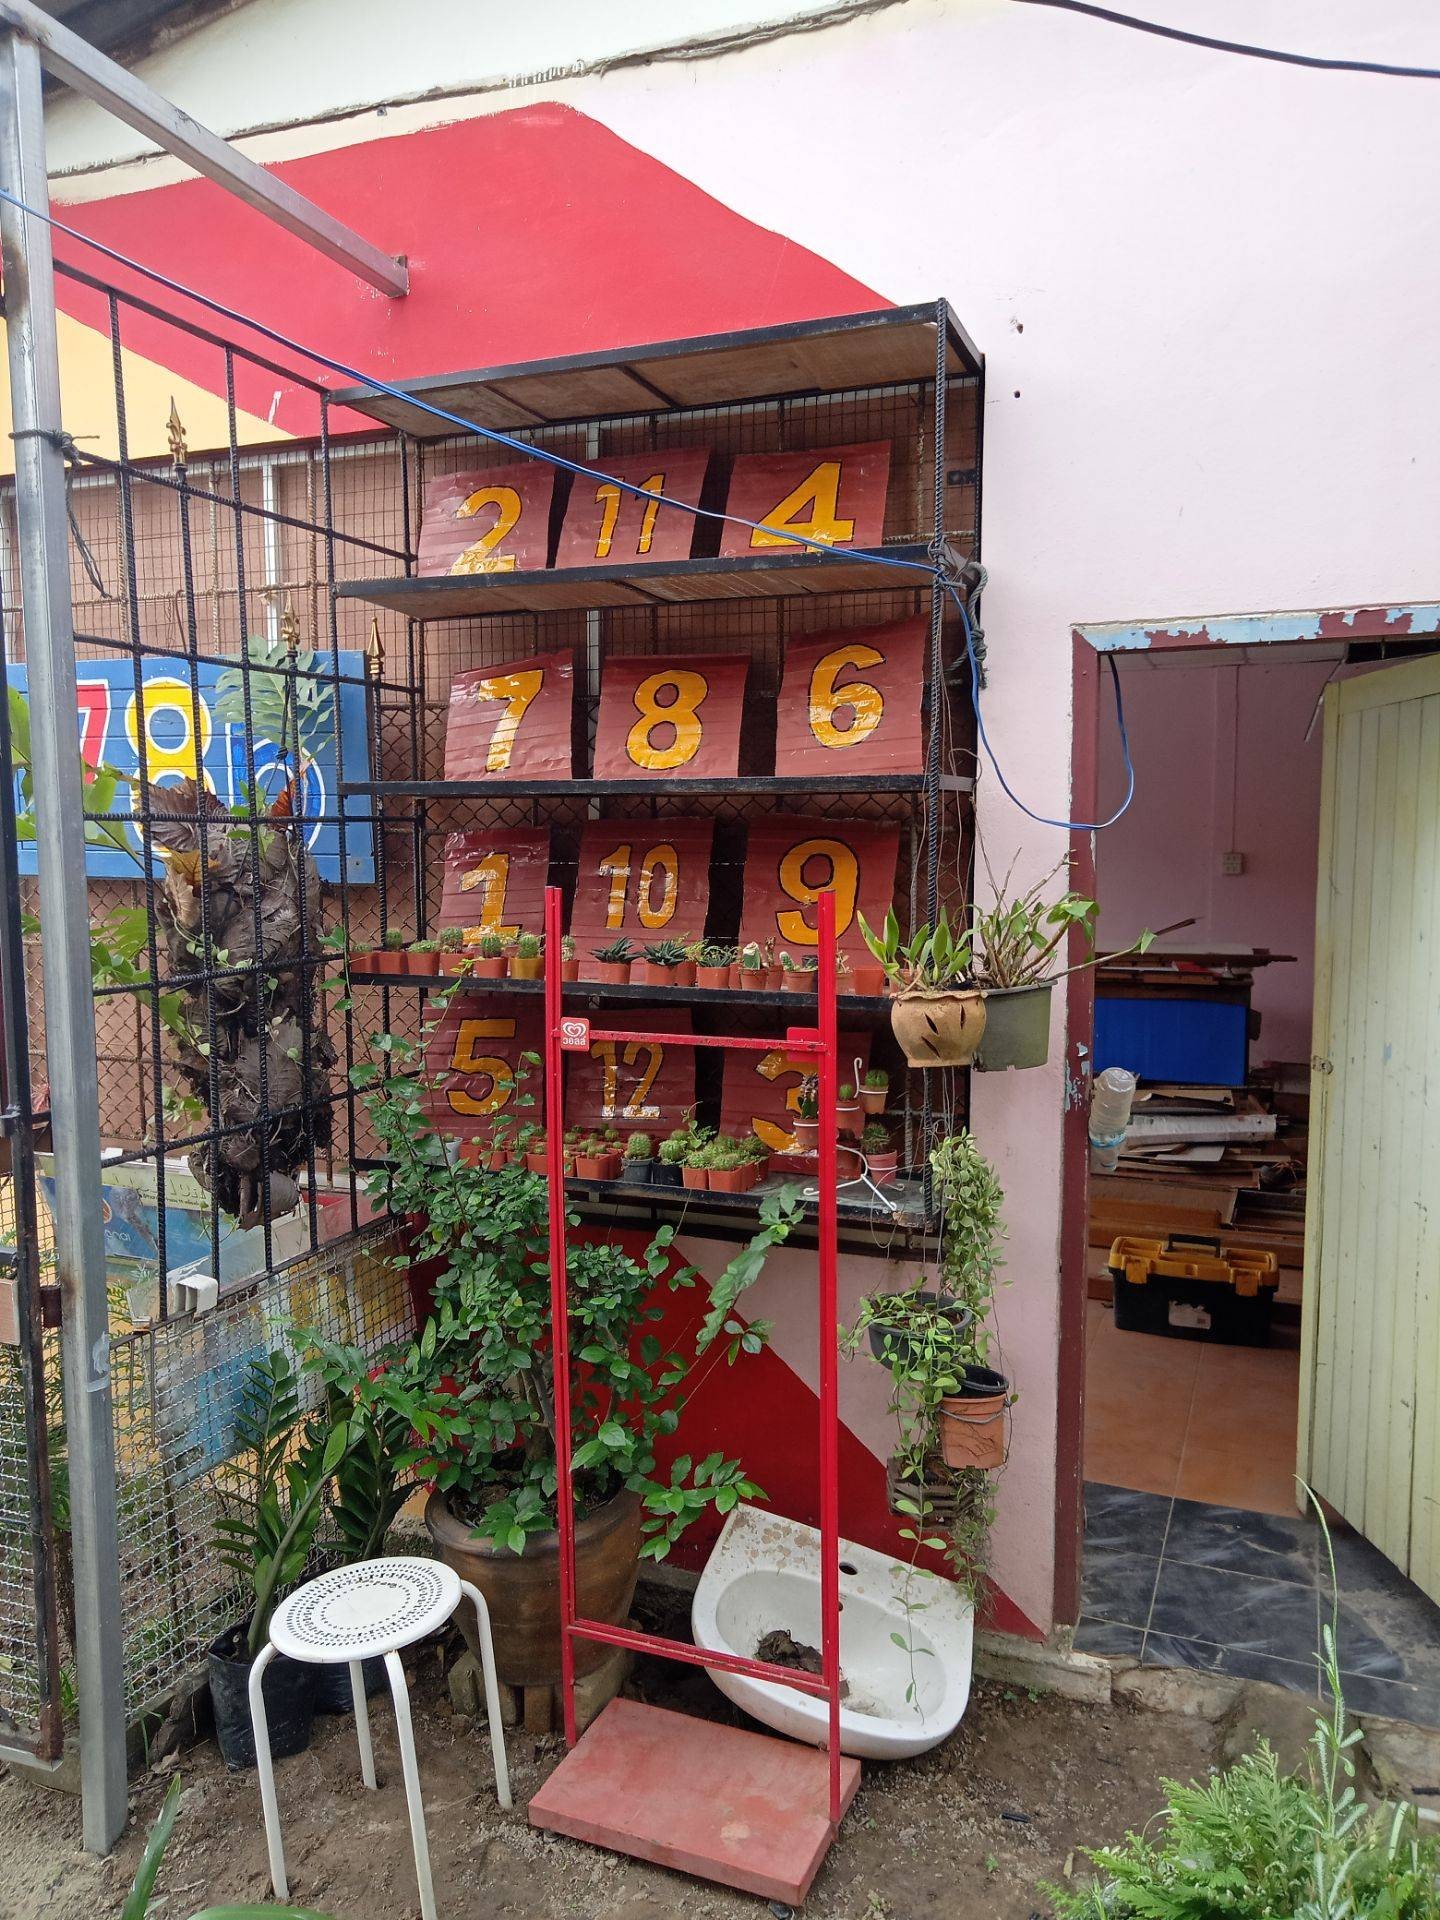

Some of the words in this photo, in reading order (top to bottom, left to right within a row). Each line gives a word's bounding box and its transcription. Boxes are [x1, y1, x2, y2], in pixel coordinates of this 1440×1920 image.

[449, 485, 522, 575] 2
[594, 473, 666, 558] 11
[750, 461, 855, 553] 4
[479, 668, 544, 773] 7
[625, 669, 710, 771] 8
[808, 644, 887, 750] 6
[459, 852, 523, 946] 1
[599, 843, 680, 930] 10
[776, 836, 861, 946] 9
[445, 1017, 517, 1118] 5
[590, 1039, 665, 1120] 12
[752, 1049, 820, 1157] 3
